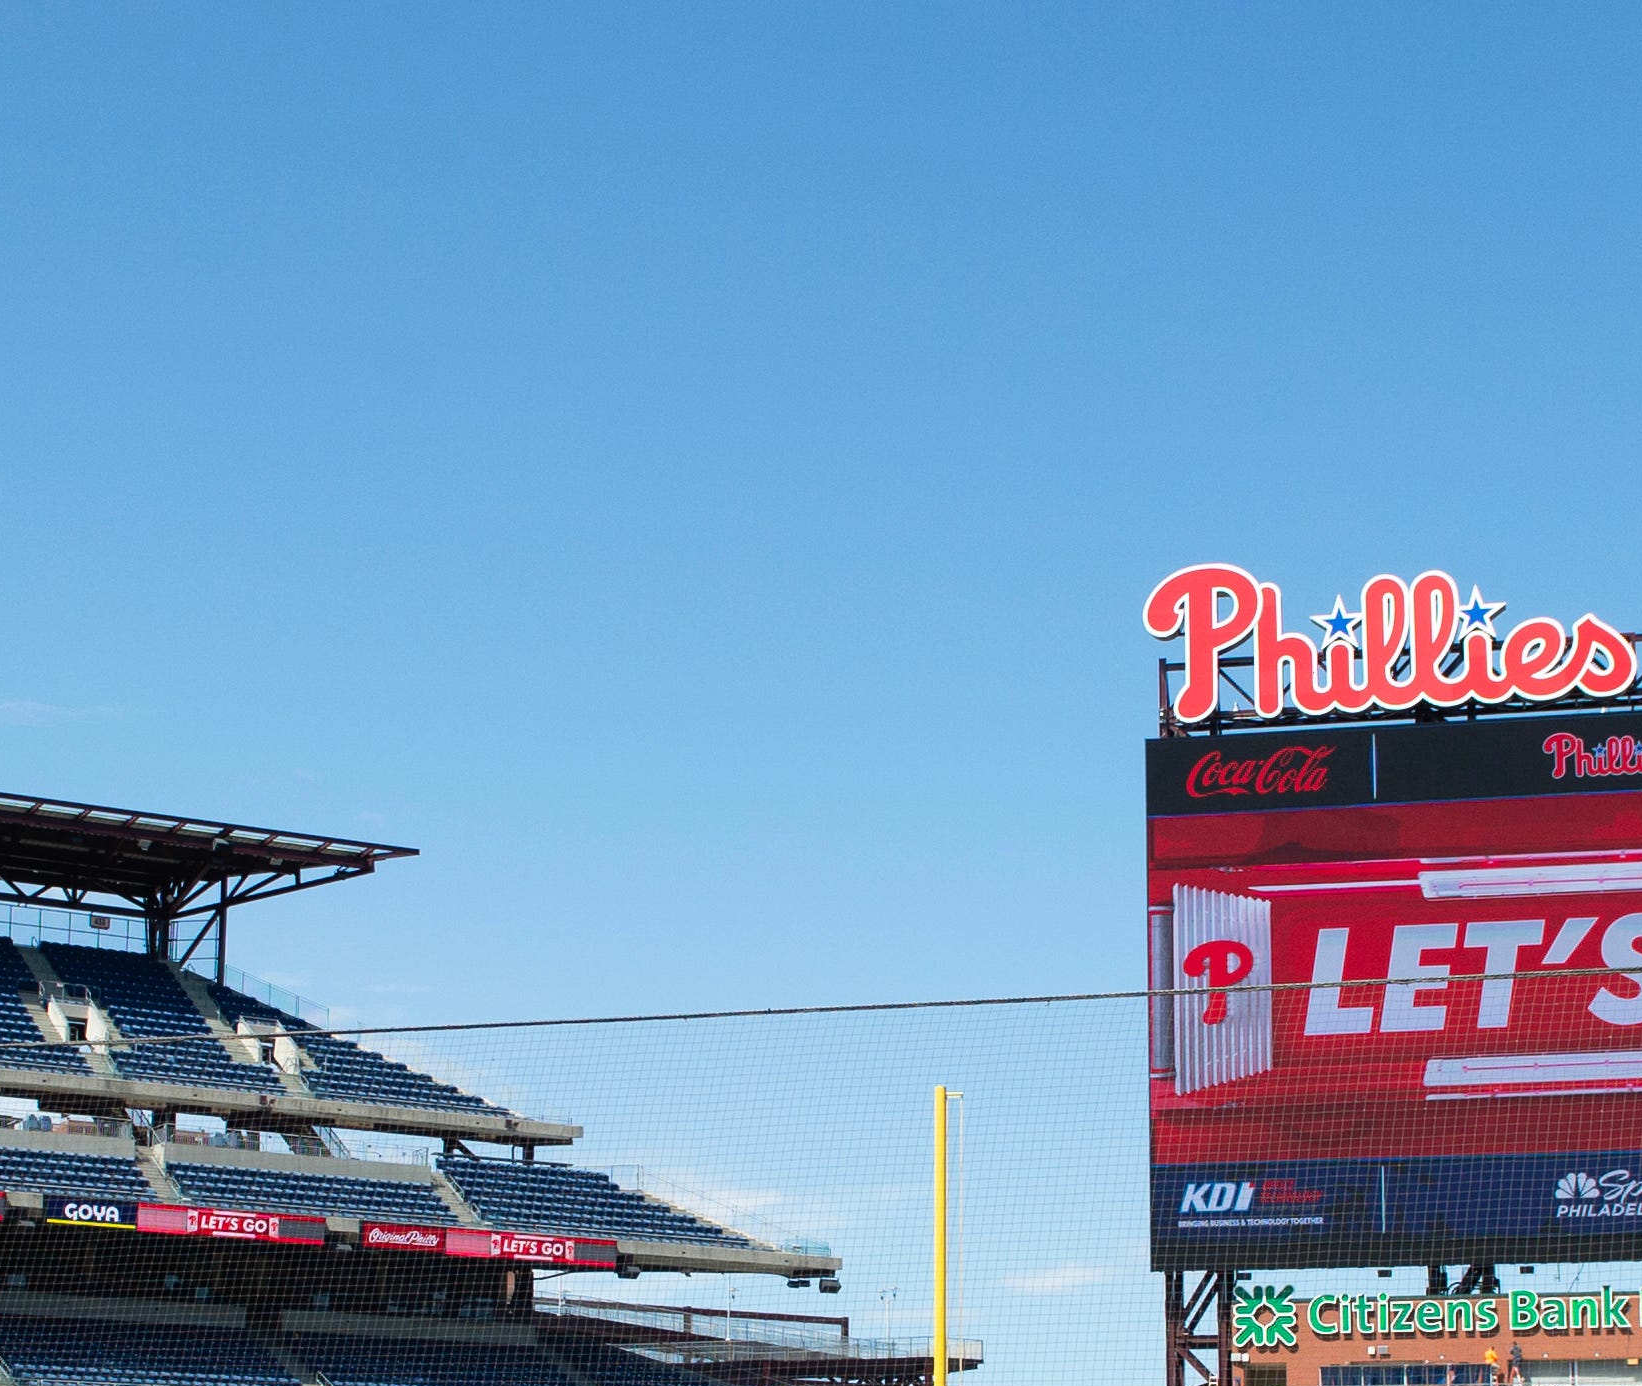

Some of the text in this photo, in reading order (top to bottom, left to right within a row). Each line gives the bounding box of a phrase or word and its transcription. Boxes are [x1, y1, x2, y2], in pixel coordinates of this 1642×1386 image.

[1143, 562, 1638, 723] Phillies
[1183, 940, 1254, 1025] P
[64, 1203, 120, 1222] GOYA
[1180, 1181, 1256, 1213] KDI
[200, 1214, 268, 1233] LET'S GO
[503, 1239, 564, 1256] LET'S GO
[1307, 1292, 1499, 1336] Citizens
[1507, 1286, 1631, 1334] Bank
